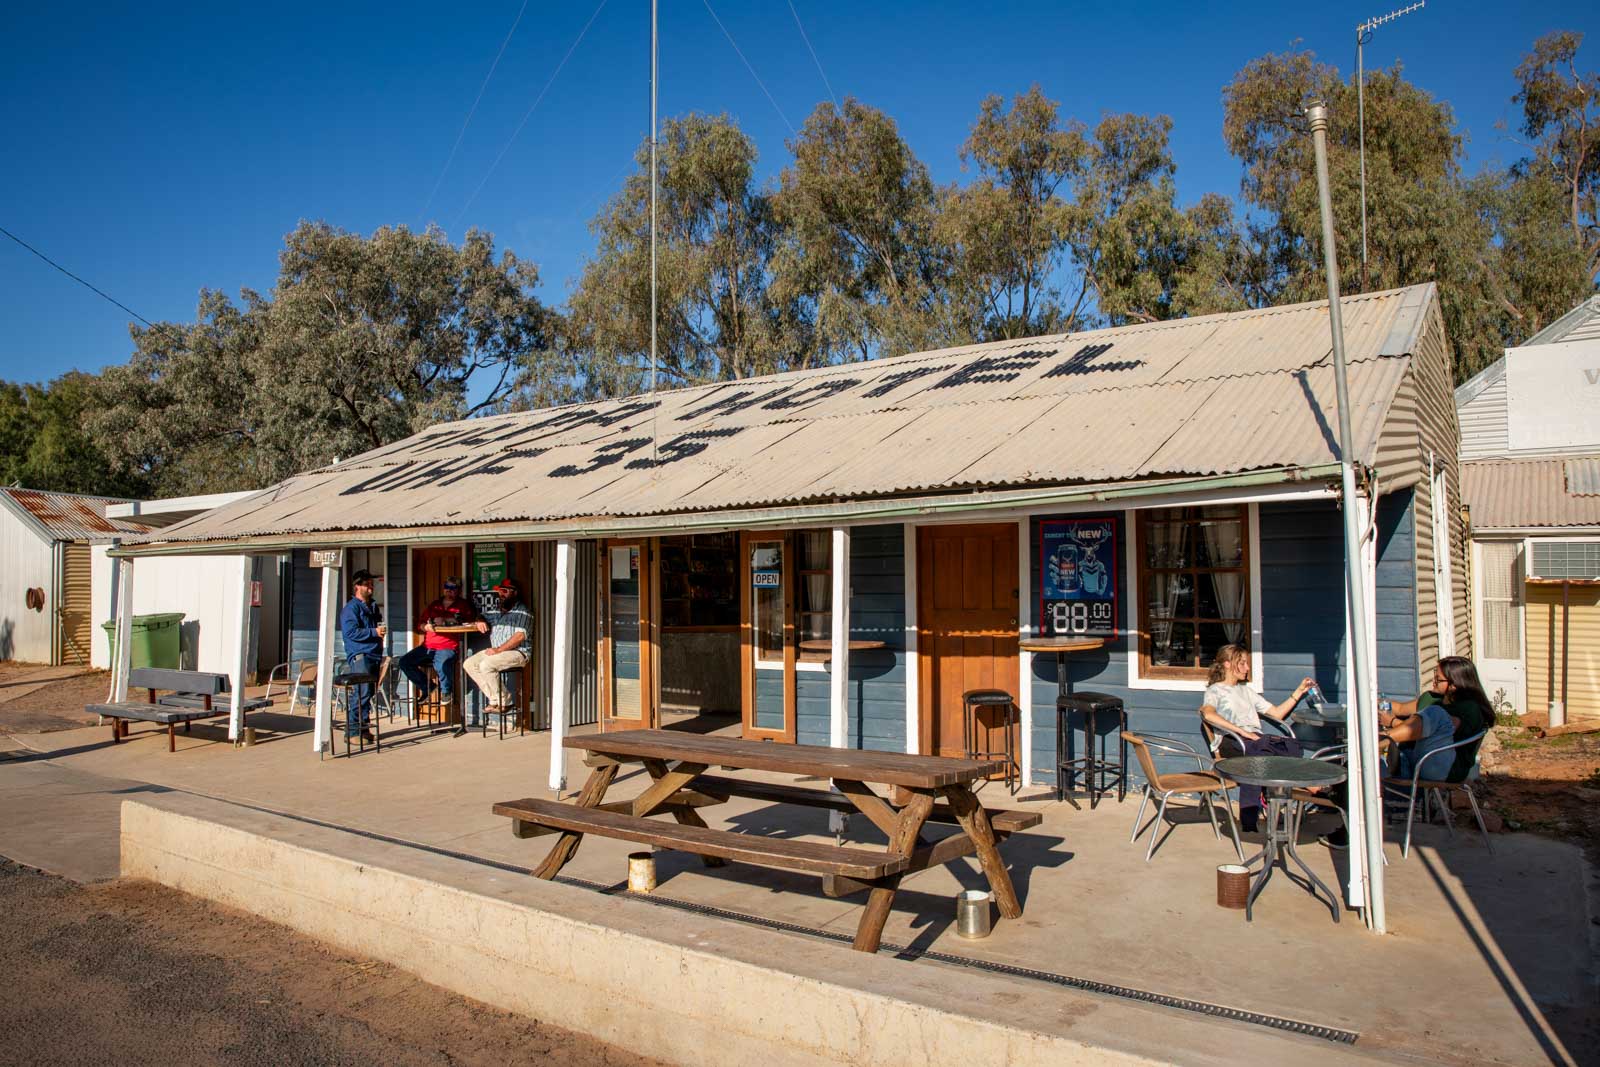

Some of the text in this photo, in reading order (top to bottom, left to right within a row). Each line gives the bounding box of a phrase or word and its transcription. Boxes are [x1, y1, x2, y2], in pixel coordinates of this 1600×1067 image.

[383, 343, 1144, 456] TILPA HOTEL
[338, 426, 745, 496] UHF 35
[1077, 529, 1102, 539] NEW
[755, 574, 778, 585] OPEN
